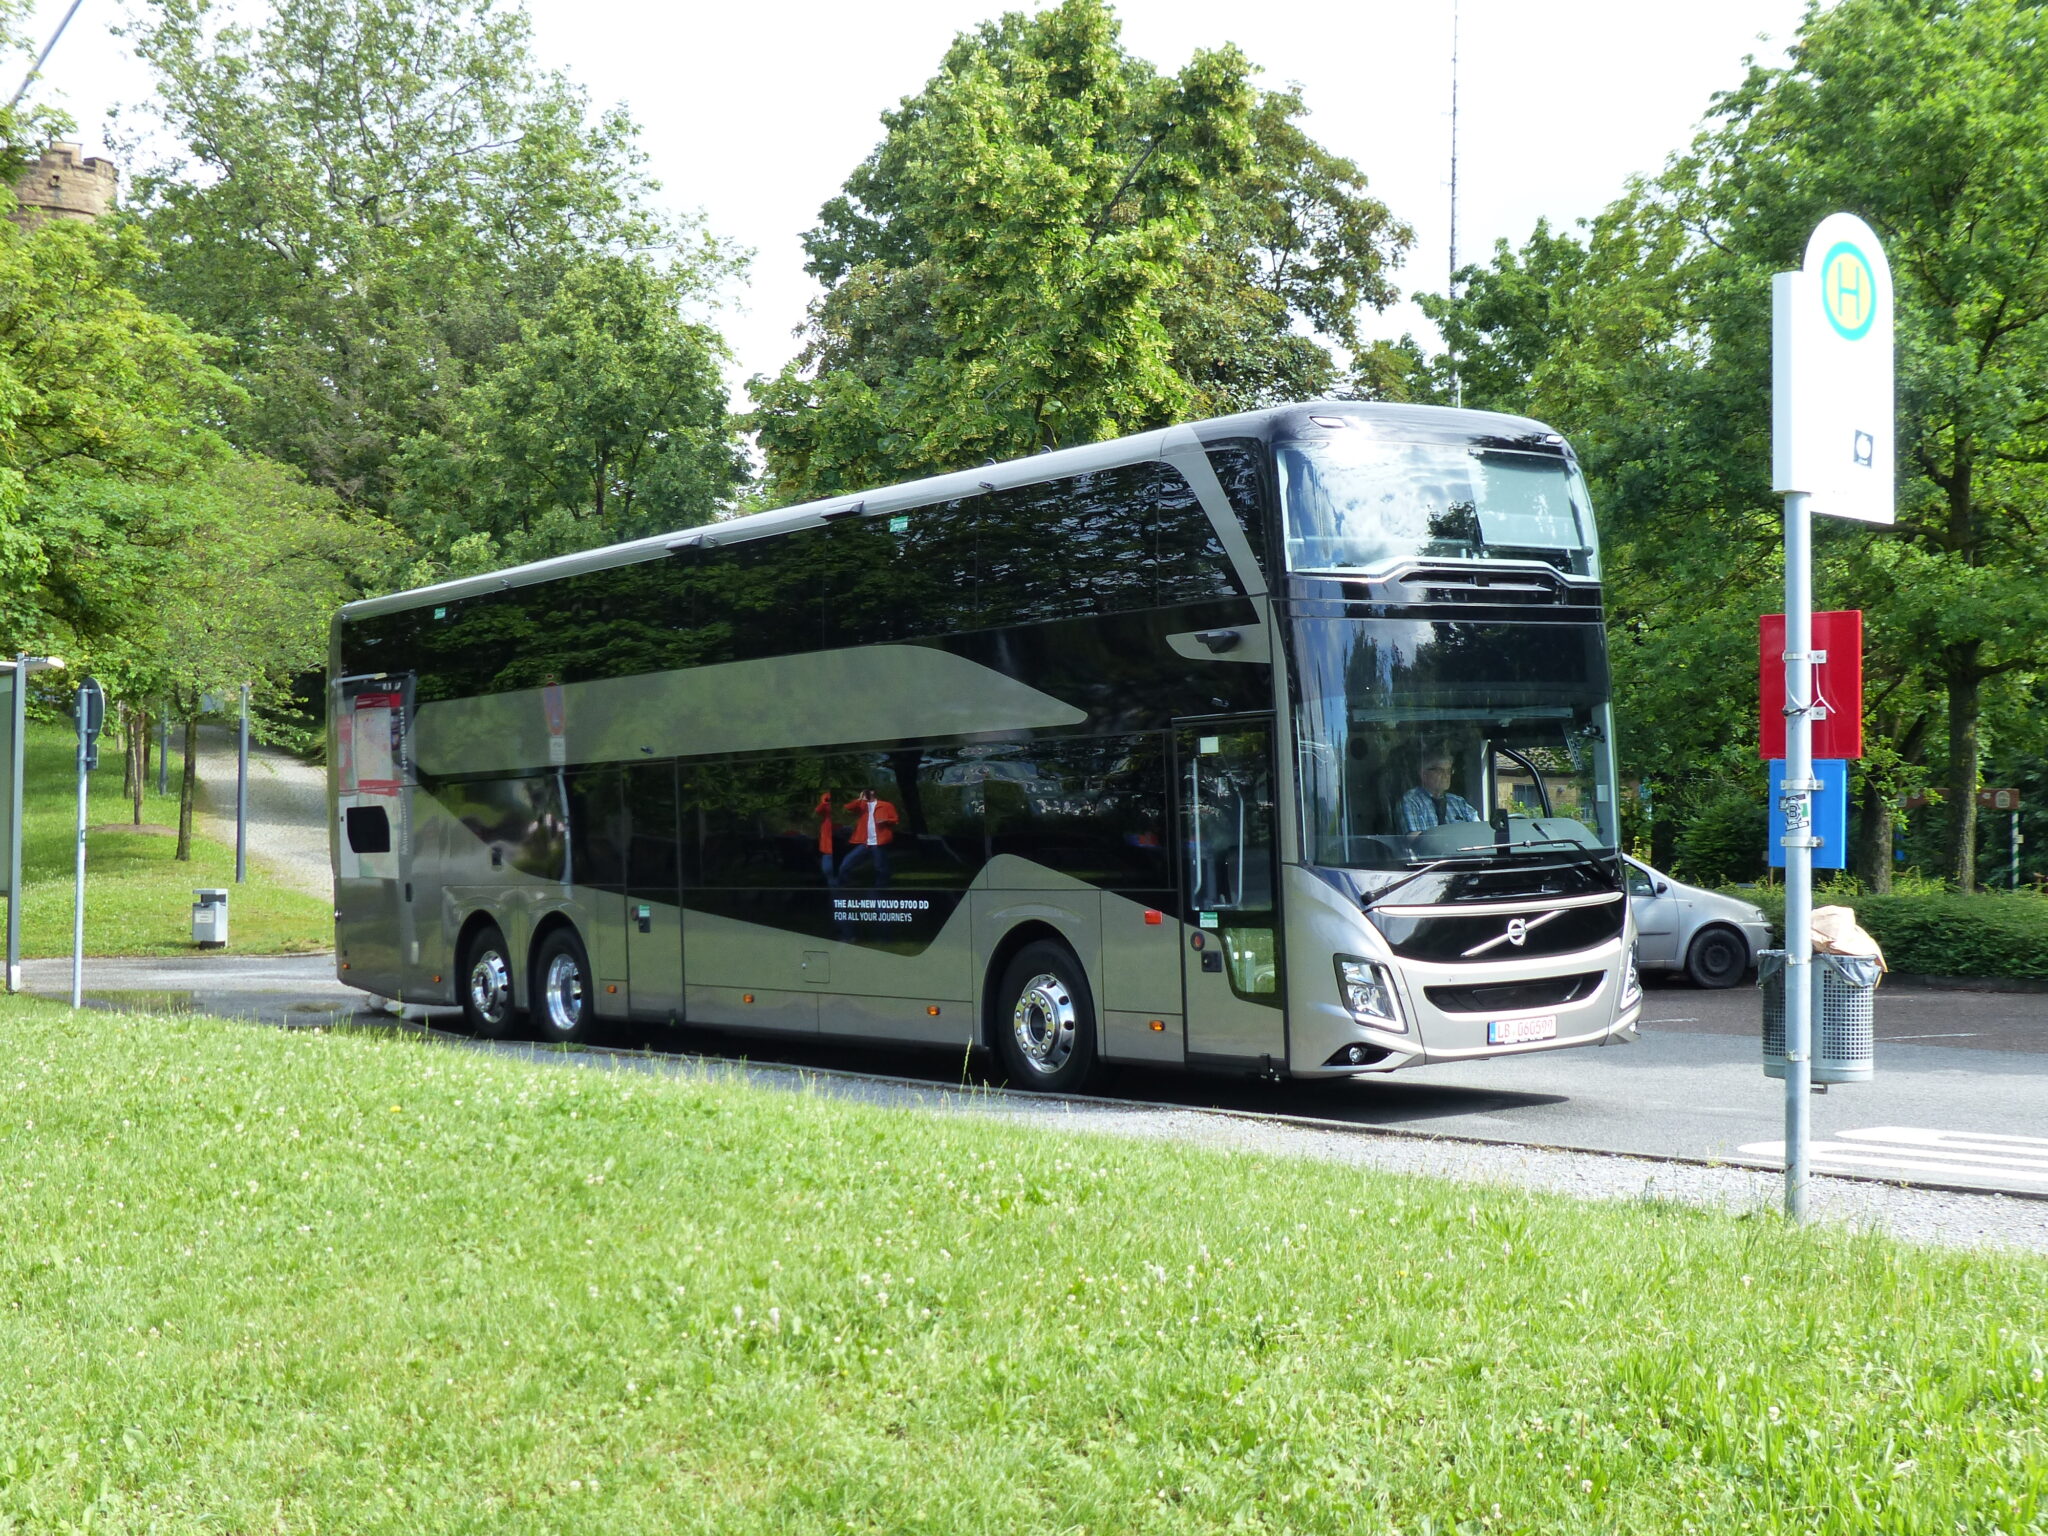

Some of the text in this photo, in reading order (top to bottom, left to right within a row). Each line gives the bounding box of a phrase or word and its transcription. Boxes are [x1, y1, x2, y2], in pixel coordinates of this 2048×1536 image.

[1838, 261, 1860, 321] H
[834, 899, 930, 910] THE ALL-NEW VOLVO 9700 DD
[834, 911, 913, 922] FOR ALL YOUR JOURNEYS
[1497, 1023, 1511, 1039] LB
